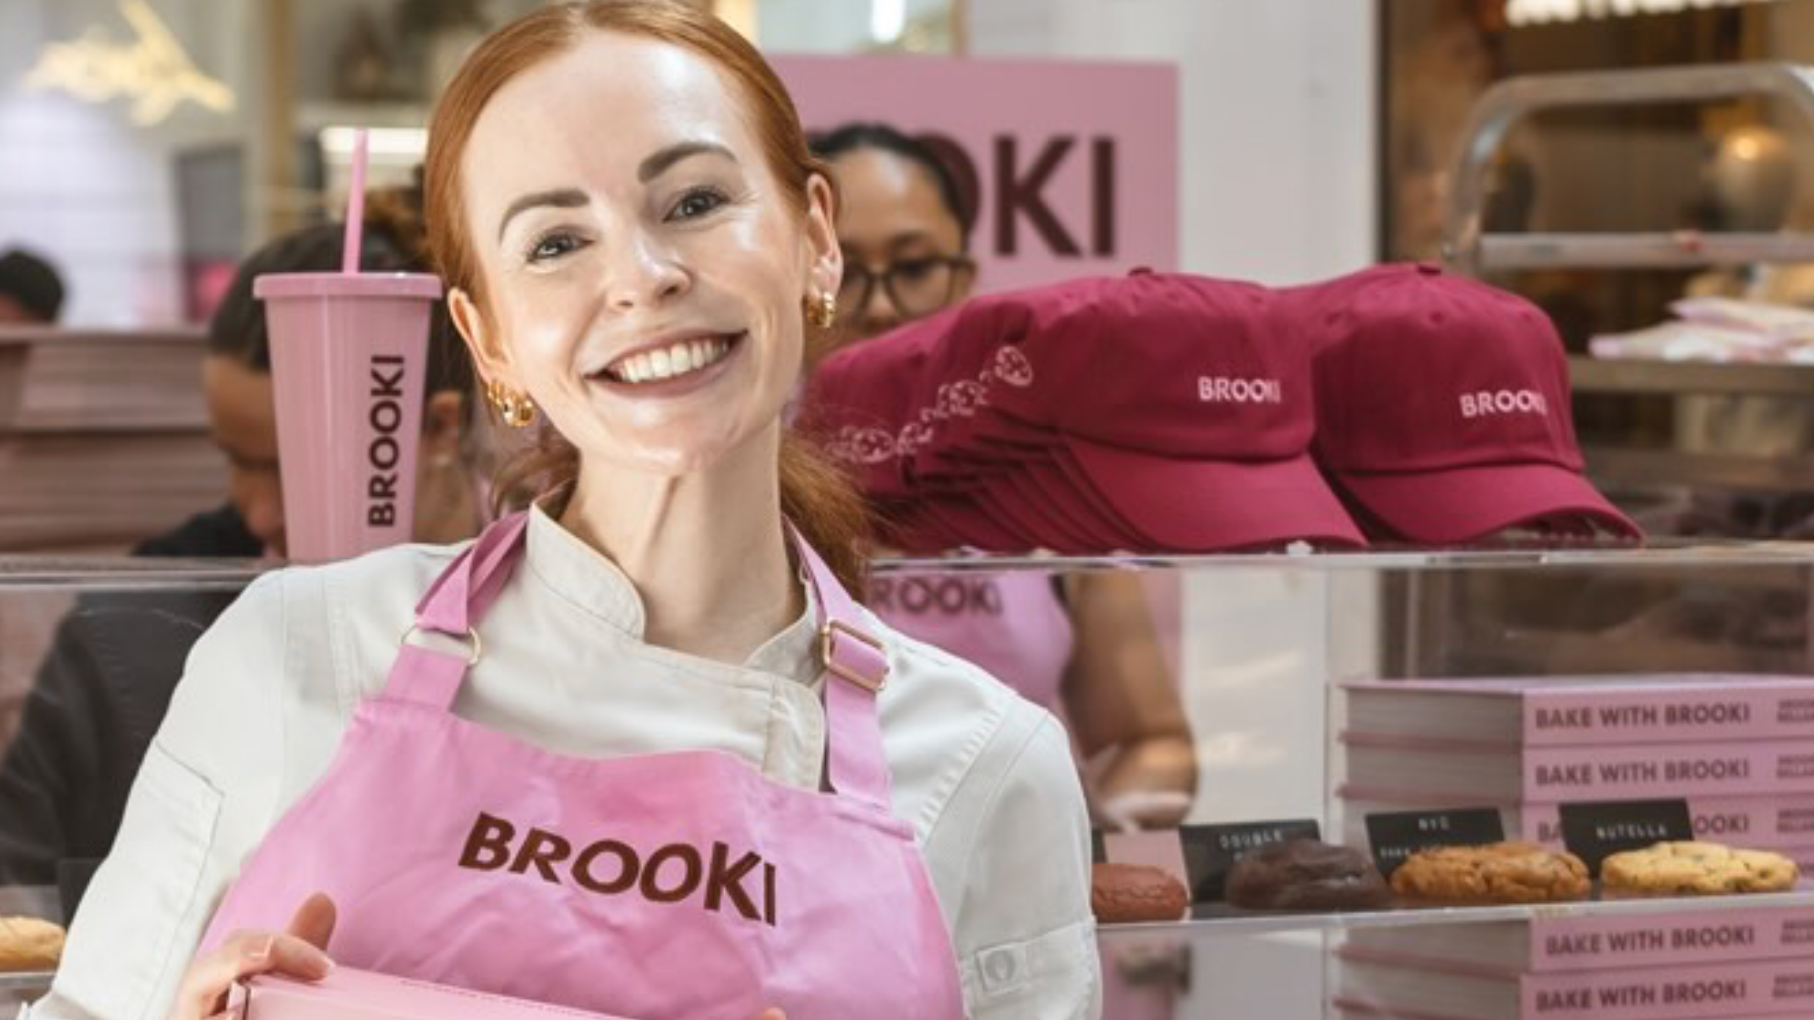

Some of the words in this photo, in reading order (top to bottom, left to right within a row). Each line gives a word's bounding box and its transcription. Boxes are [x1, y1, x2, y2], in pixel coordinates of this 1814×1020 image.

[367, 355, 405, 528] BROOKI
[1535, 707, 1593, 730] BAKE
[1600, 705, 1658, 728] WITH
[1664, 702, 1750, 726] BROOKI
[1535, 763, 1593, 786] BAKE
[1600, 760, 1658, 783] WITH
[1664, 757, 1749, 782] BROOKI
[1595, 822, 1668, 840] NUTELLA
[1693, 814, 1750, 834] OOKI
[1218, 829, 1284, 850] DOUBLE
[457, 811, 777, 928] BROOKI
[1545, 933, 1601, 957] BAKE
[1607, 929, 1664, 952] WITH
[1671, 926, 1755, 949] BROOKI
[1535, 987, 1593, 1012] BAKE
[1599, 984, 1656, 1007] WITH
[1663, 978, 1746, 1004] BROOKI
